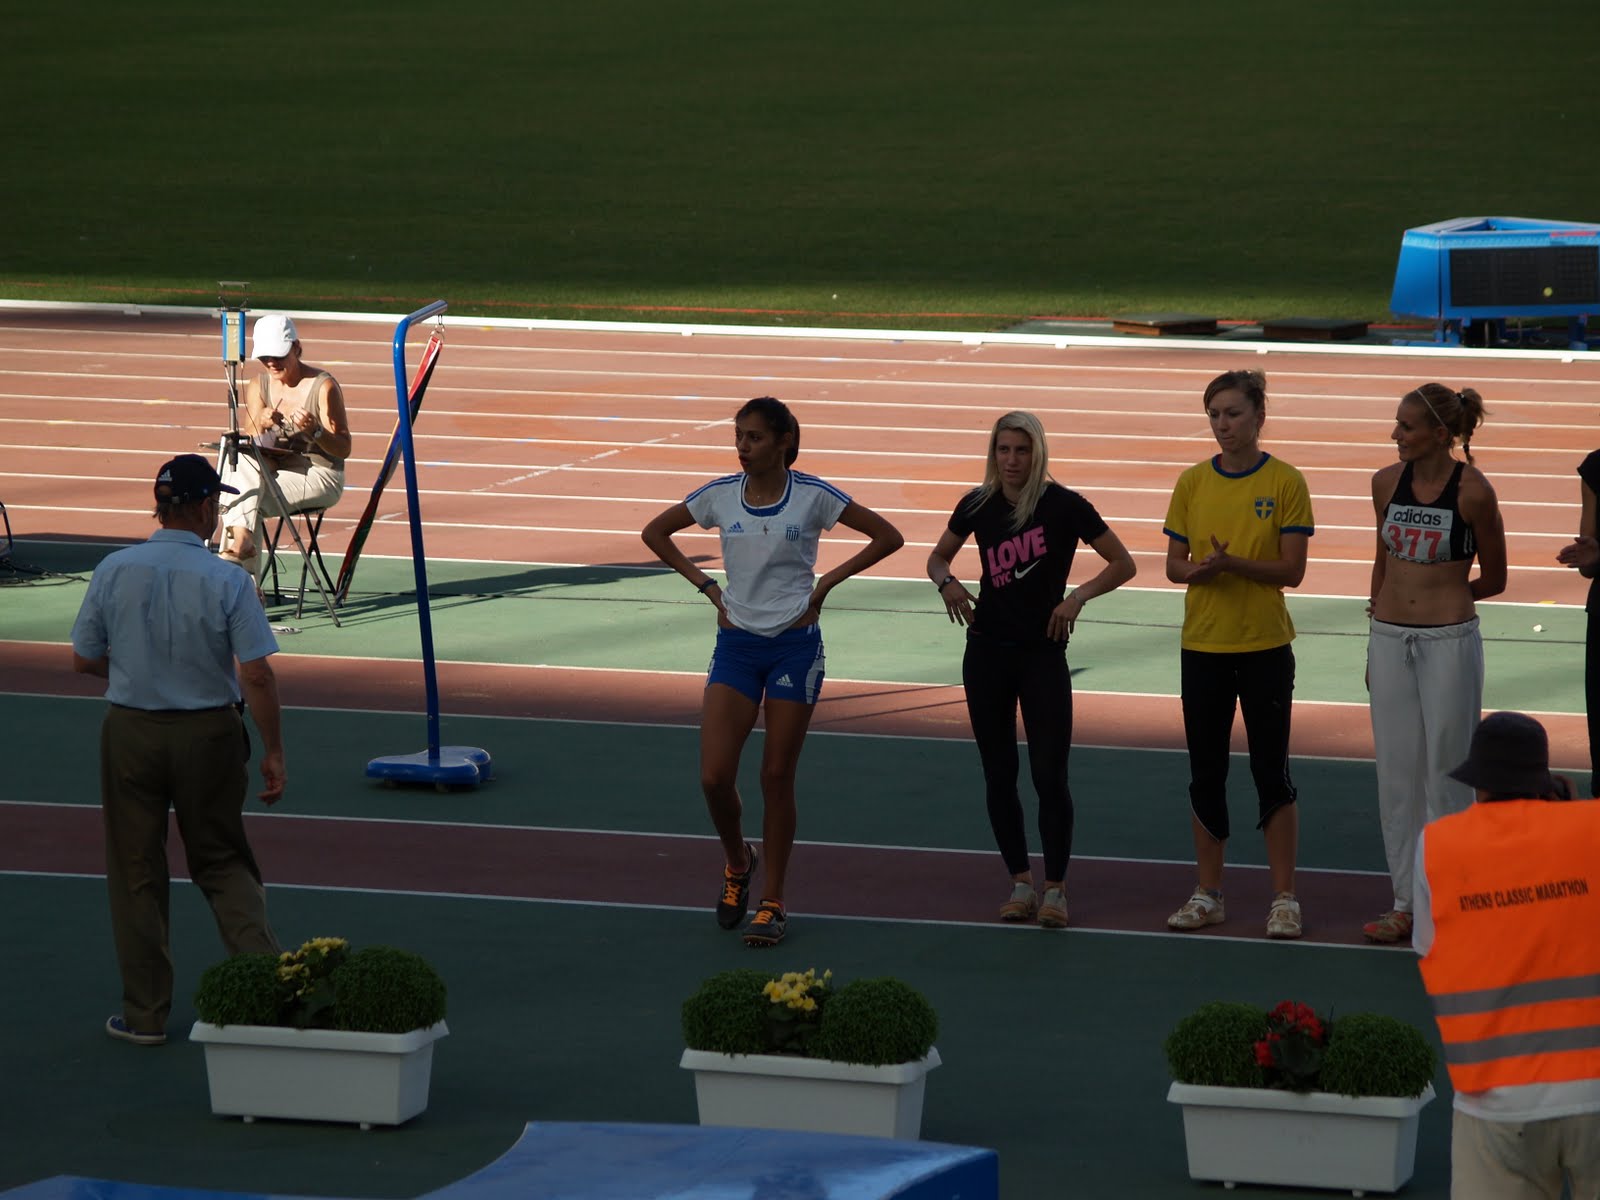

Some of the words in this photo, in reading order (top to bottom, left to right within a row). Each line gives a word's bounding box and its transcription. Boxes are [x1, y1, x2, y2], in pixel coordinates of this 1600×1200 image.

[1394, 508, 1441, 525] adidas
[987, 525, 1047, 576] LOVE
[1388, 524, 1442, 559] 377
[992, 571, 1011, 588] NYC
[1459, 892, 1492, 911] ATHENS
[1494, 886, 1533, 907] CLASSIC
[1535, 879, 1588, 901] MARATHON
